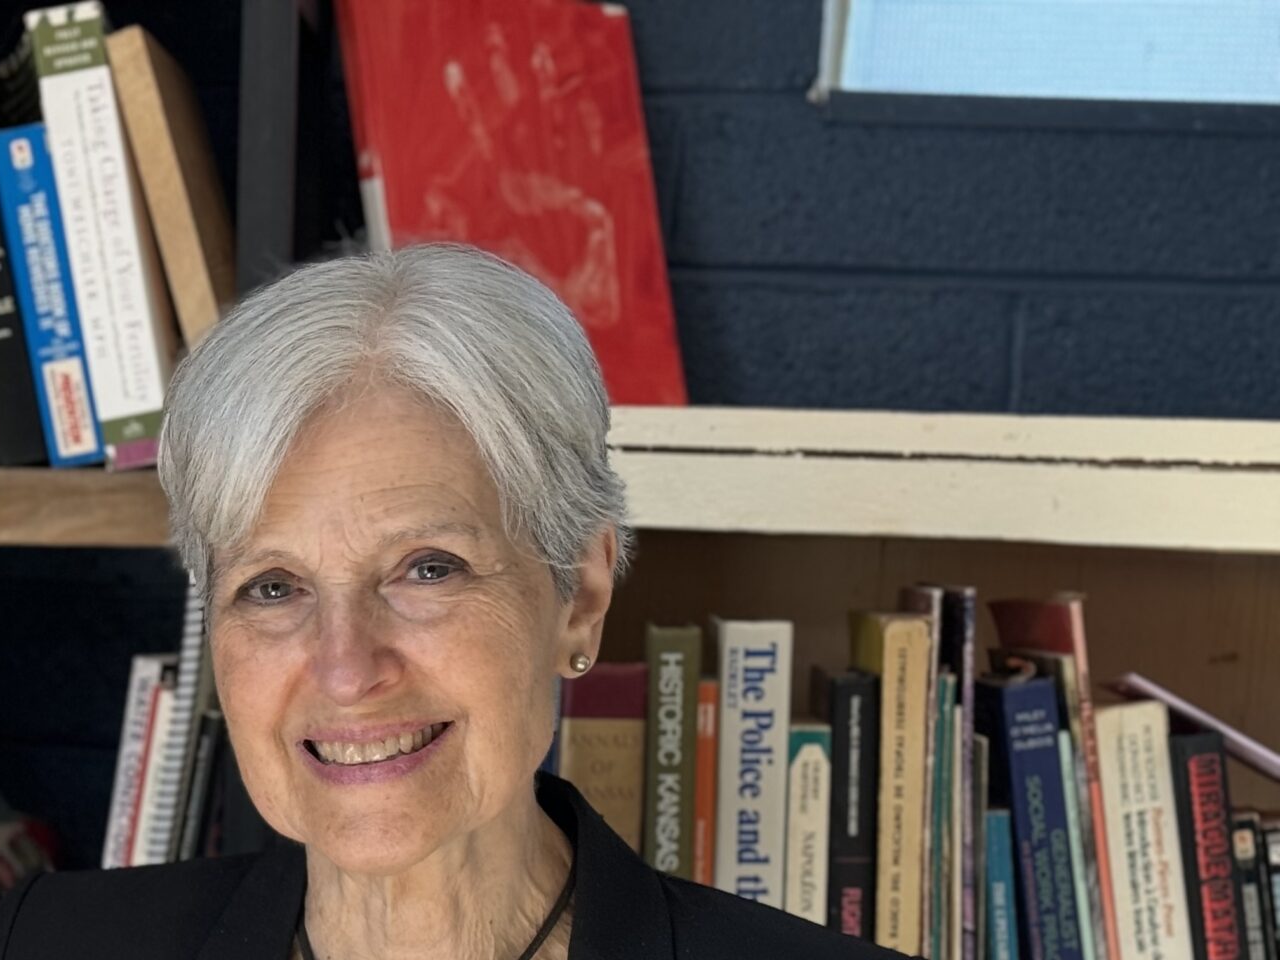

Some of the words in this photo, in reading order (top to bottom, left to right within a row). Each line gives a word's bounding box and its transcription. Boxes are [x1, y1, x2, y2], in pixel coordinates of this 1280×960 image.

[84, 80, 115, 152] Taking
[95, 154, 126, 227] Charge
[110, 260, 138, 312] Your
[118, 318, 152, 404] Fertility
[657, 652, 683, 764] HISTORIC
[742, 641, 777, 702] The
[739, 708, 775, 800] Police
[654, 773, 680, 870] KANSAS
[736, 809, 771, 866] and
[1022, 775, 1048, 850] SOCIAL
[1185, 752, 1231, 880] MIRACLE
[735, 874, 769, 903] th
[1032, 854, 1057, 918] WORK
[1046, 827, 1080, 950] GENERALIST
